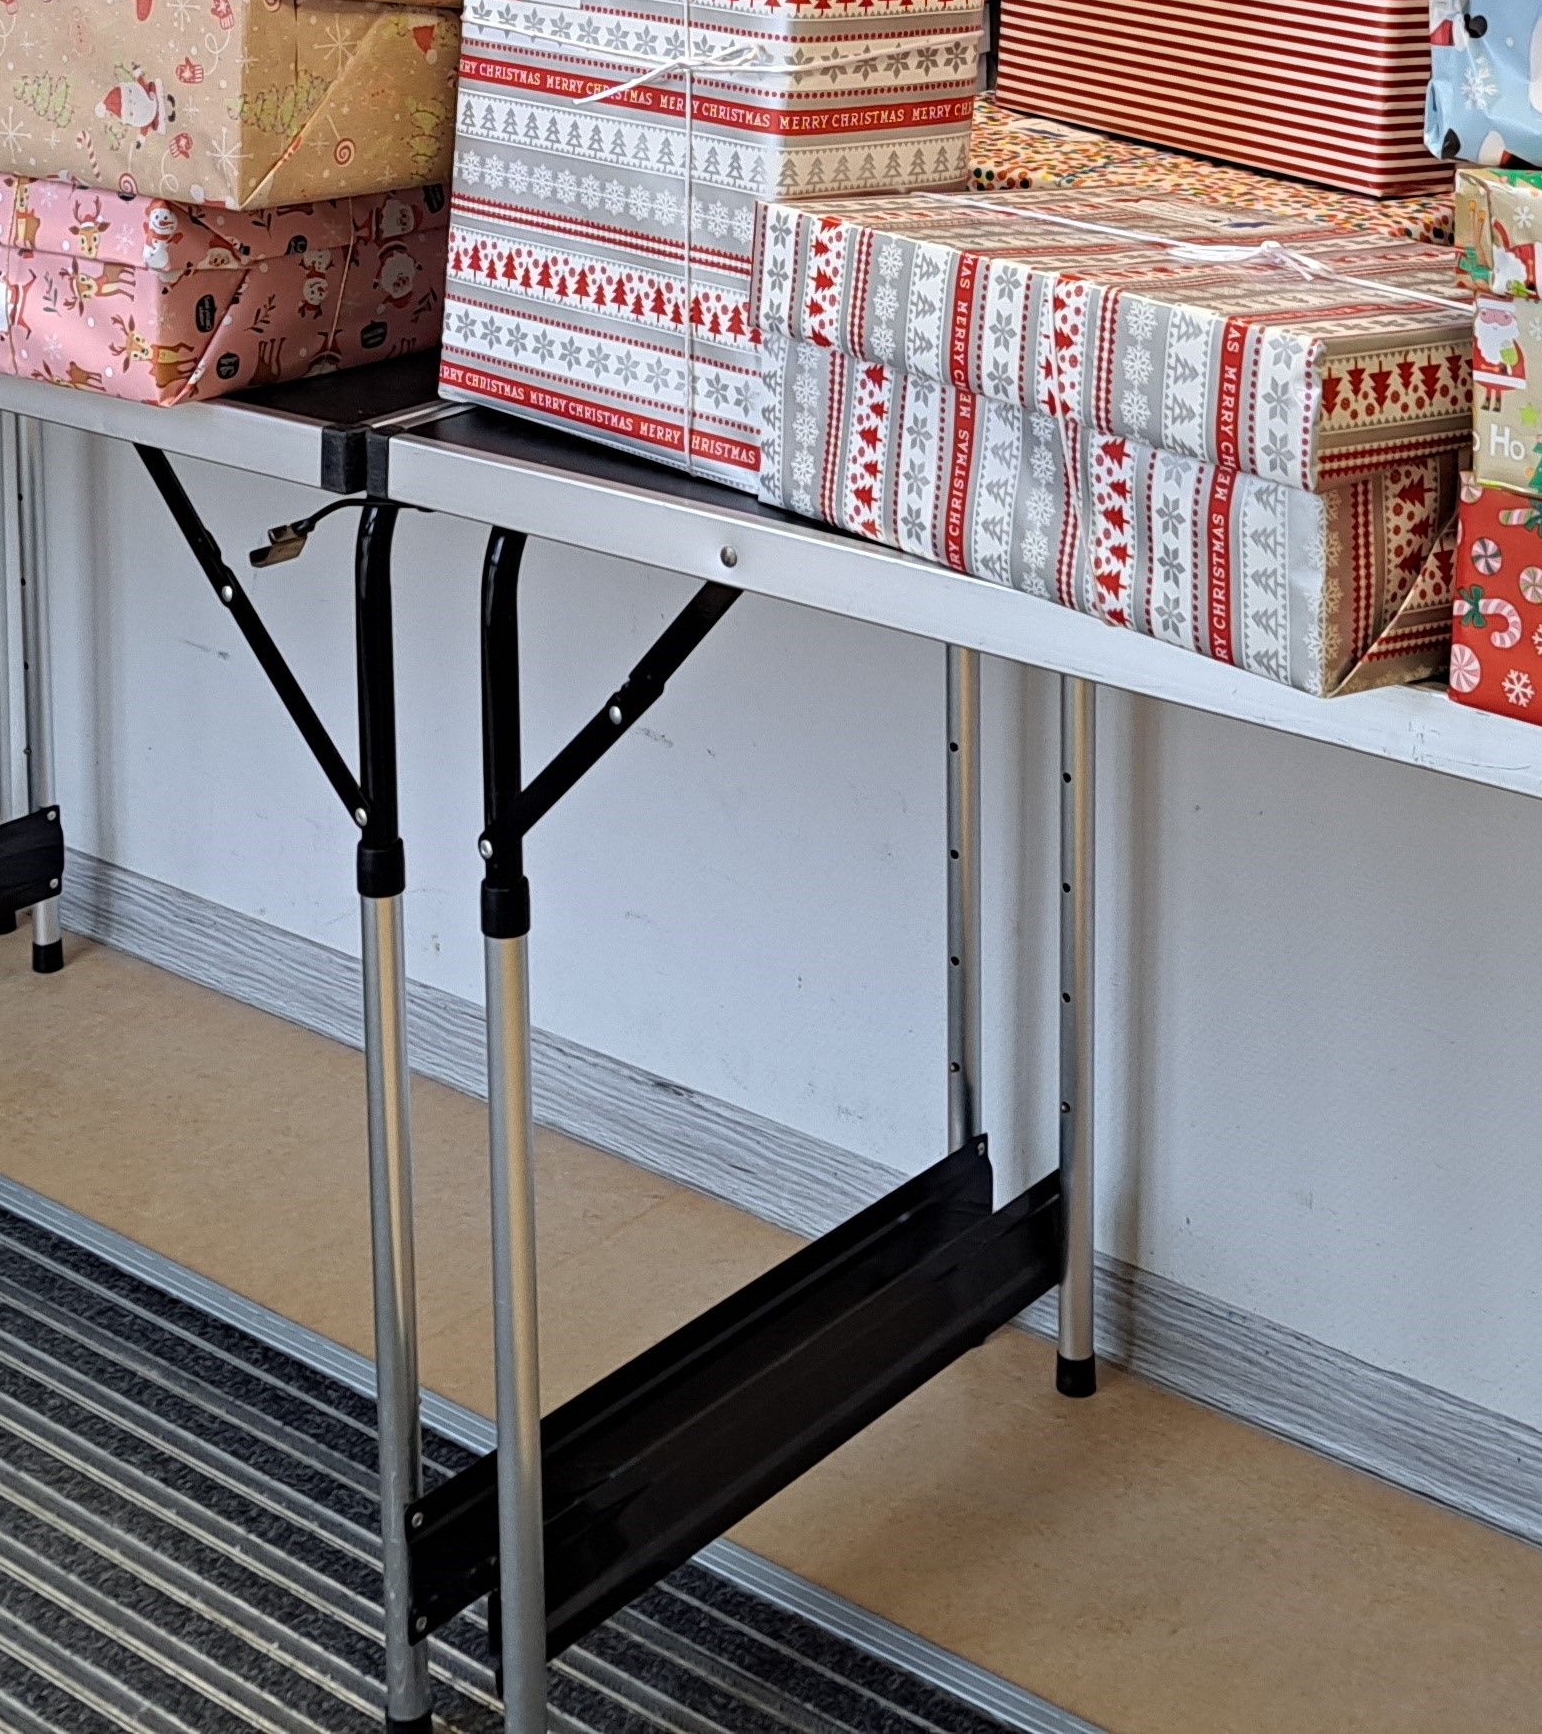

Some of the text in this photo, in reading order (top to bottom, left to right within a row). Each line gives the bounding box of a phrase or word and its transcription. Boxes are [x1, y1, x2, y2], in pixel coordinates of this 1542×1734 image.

[479, 63, 540, 86] CHRISTMAS
[546, 75, 583, 94] MERRY
[660, 95, 699, 116] MERY
[702, 104, 771, 128] CHRISTMAS
[779, 114, 828, 130] MERRY
[832, 109, 905, 128] CHRISTMAS
[912, 104, 952, 121] MERRY
[952, 301, 970, 367] MERRY
[439, 365, 756, 464] RRY CHRISTMAS MERRY CHRISTMAS MERRY HRISTMAS
[1220, 366, 1238, 439] MERRY
[1489, 423, 1526, 462] Ho
[949, 430, 971, 540] CHRISTMAS
[1211, 513, 1227, 630] CHRISTMAS
